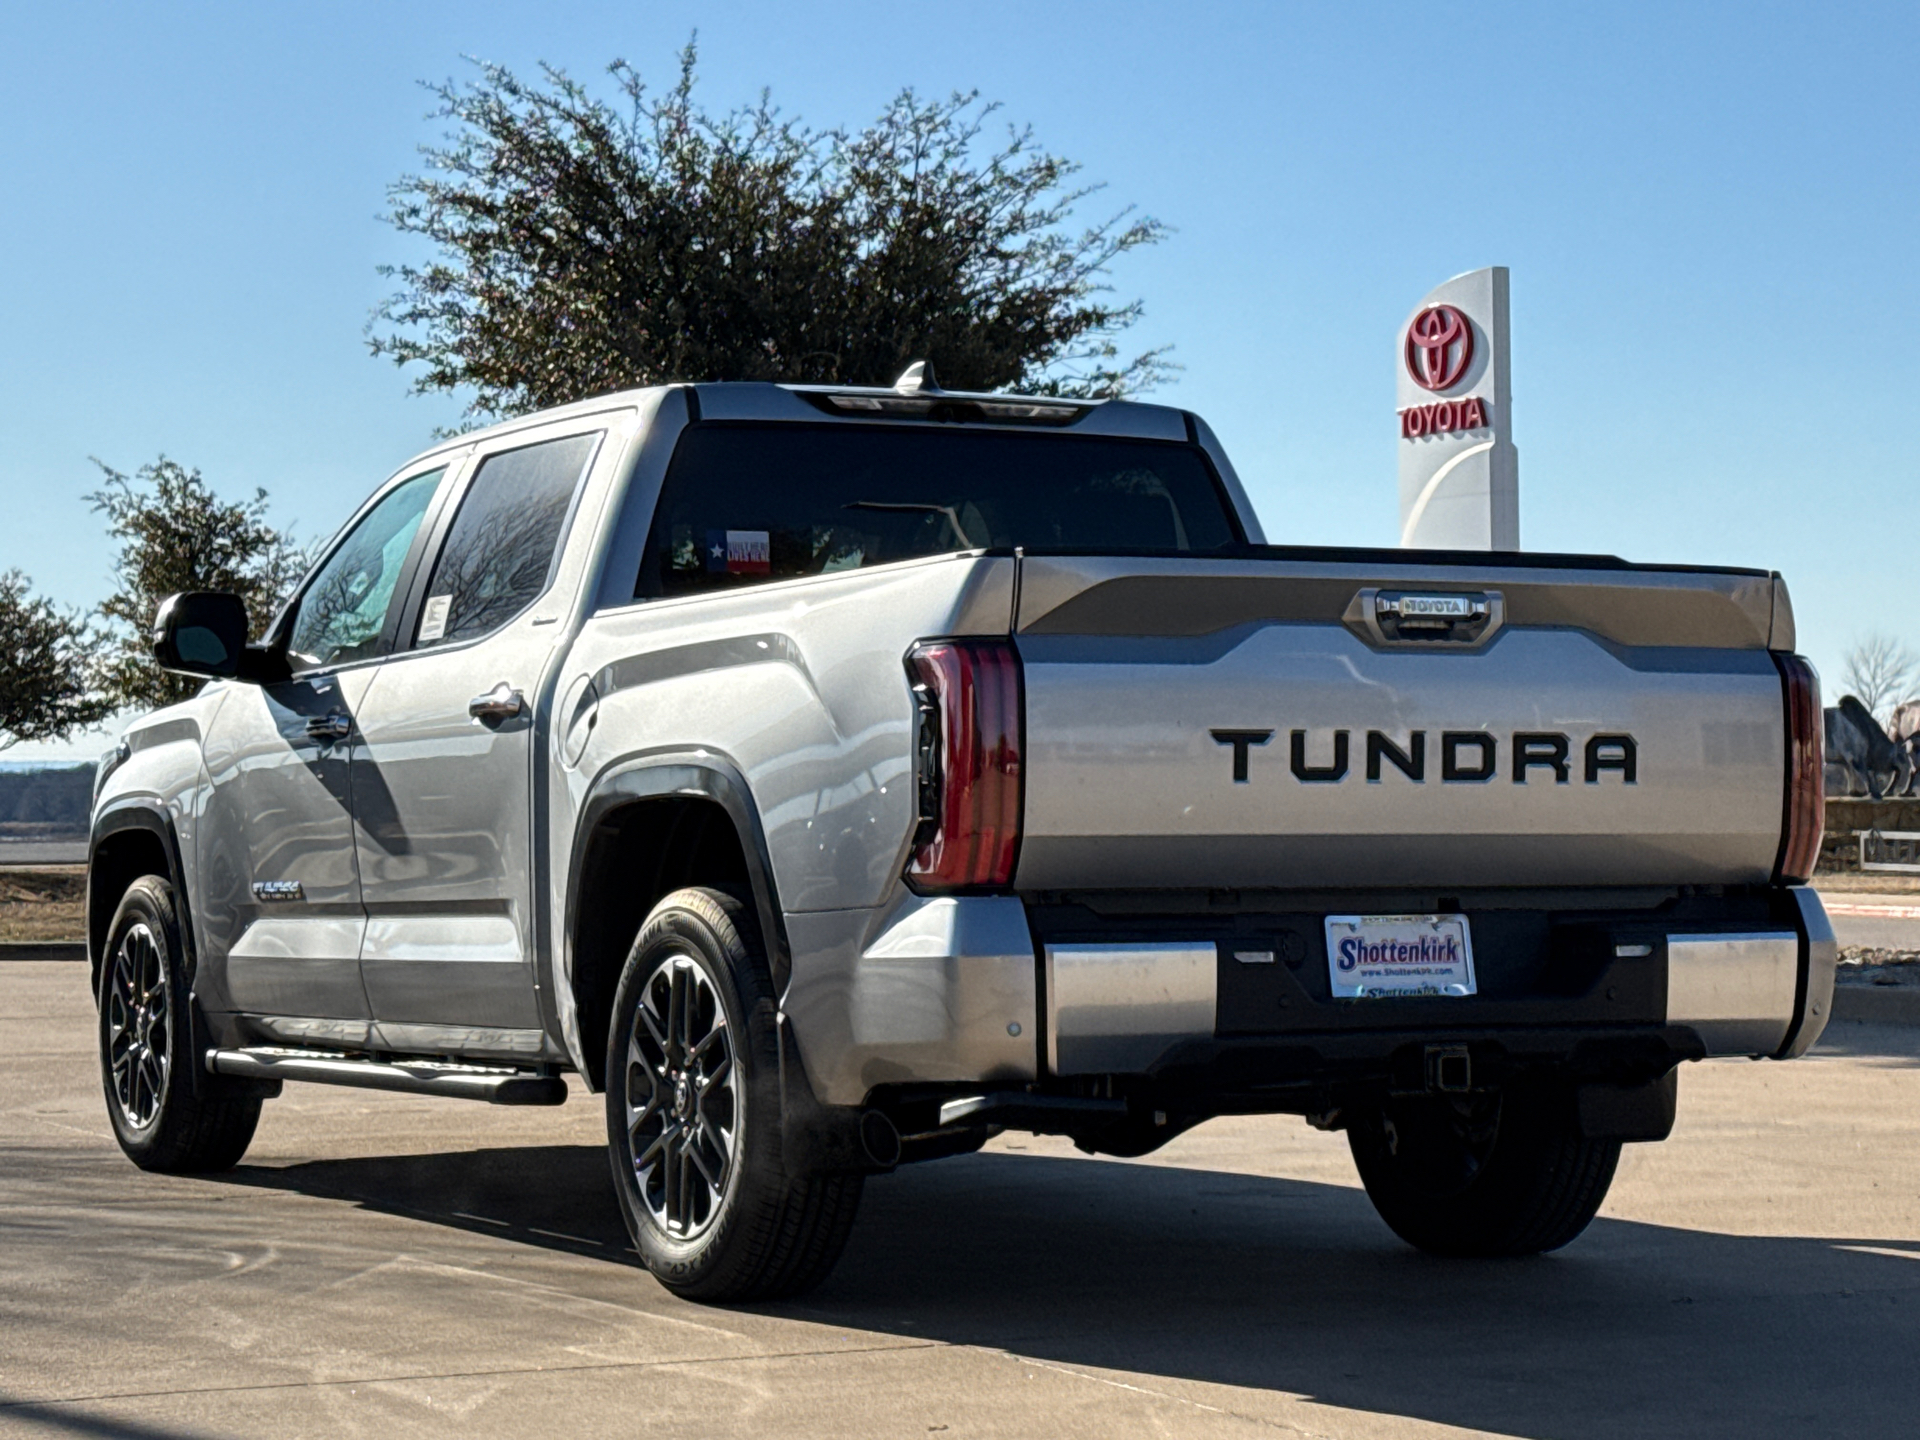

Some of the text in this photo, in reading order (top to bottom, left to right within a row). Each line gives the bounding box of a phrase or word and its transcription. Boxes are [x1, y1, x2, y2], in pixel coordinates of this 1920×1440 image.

[1396, 396, 1488, 438] TOYOTA
[1407, 600, 1462, 613] TOYOTA
[1209, 728, 1638, 784] TUNDRA
[1338, 935, 1459, 971] Shottenkirk
